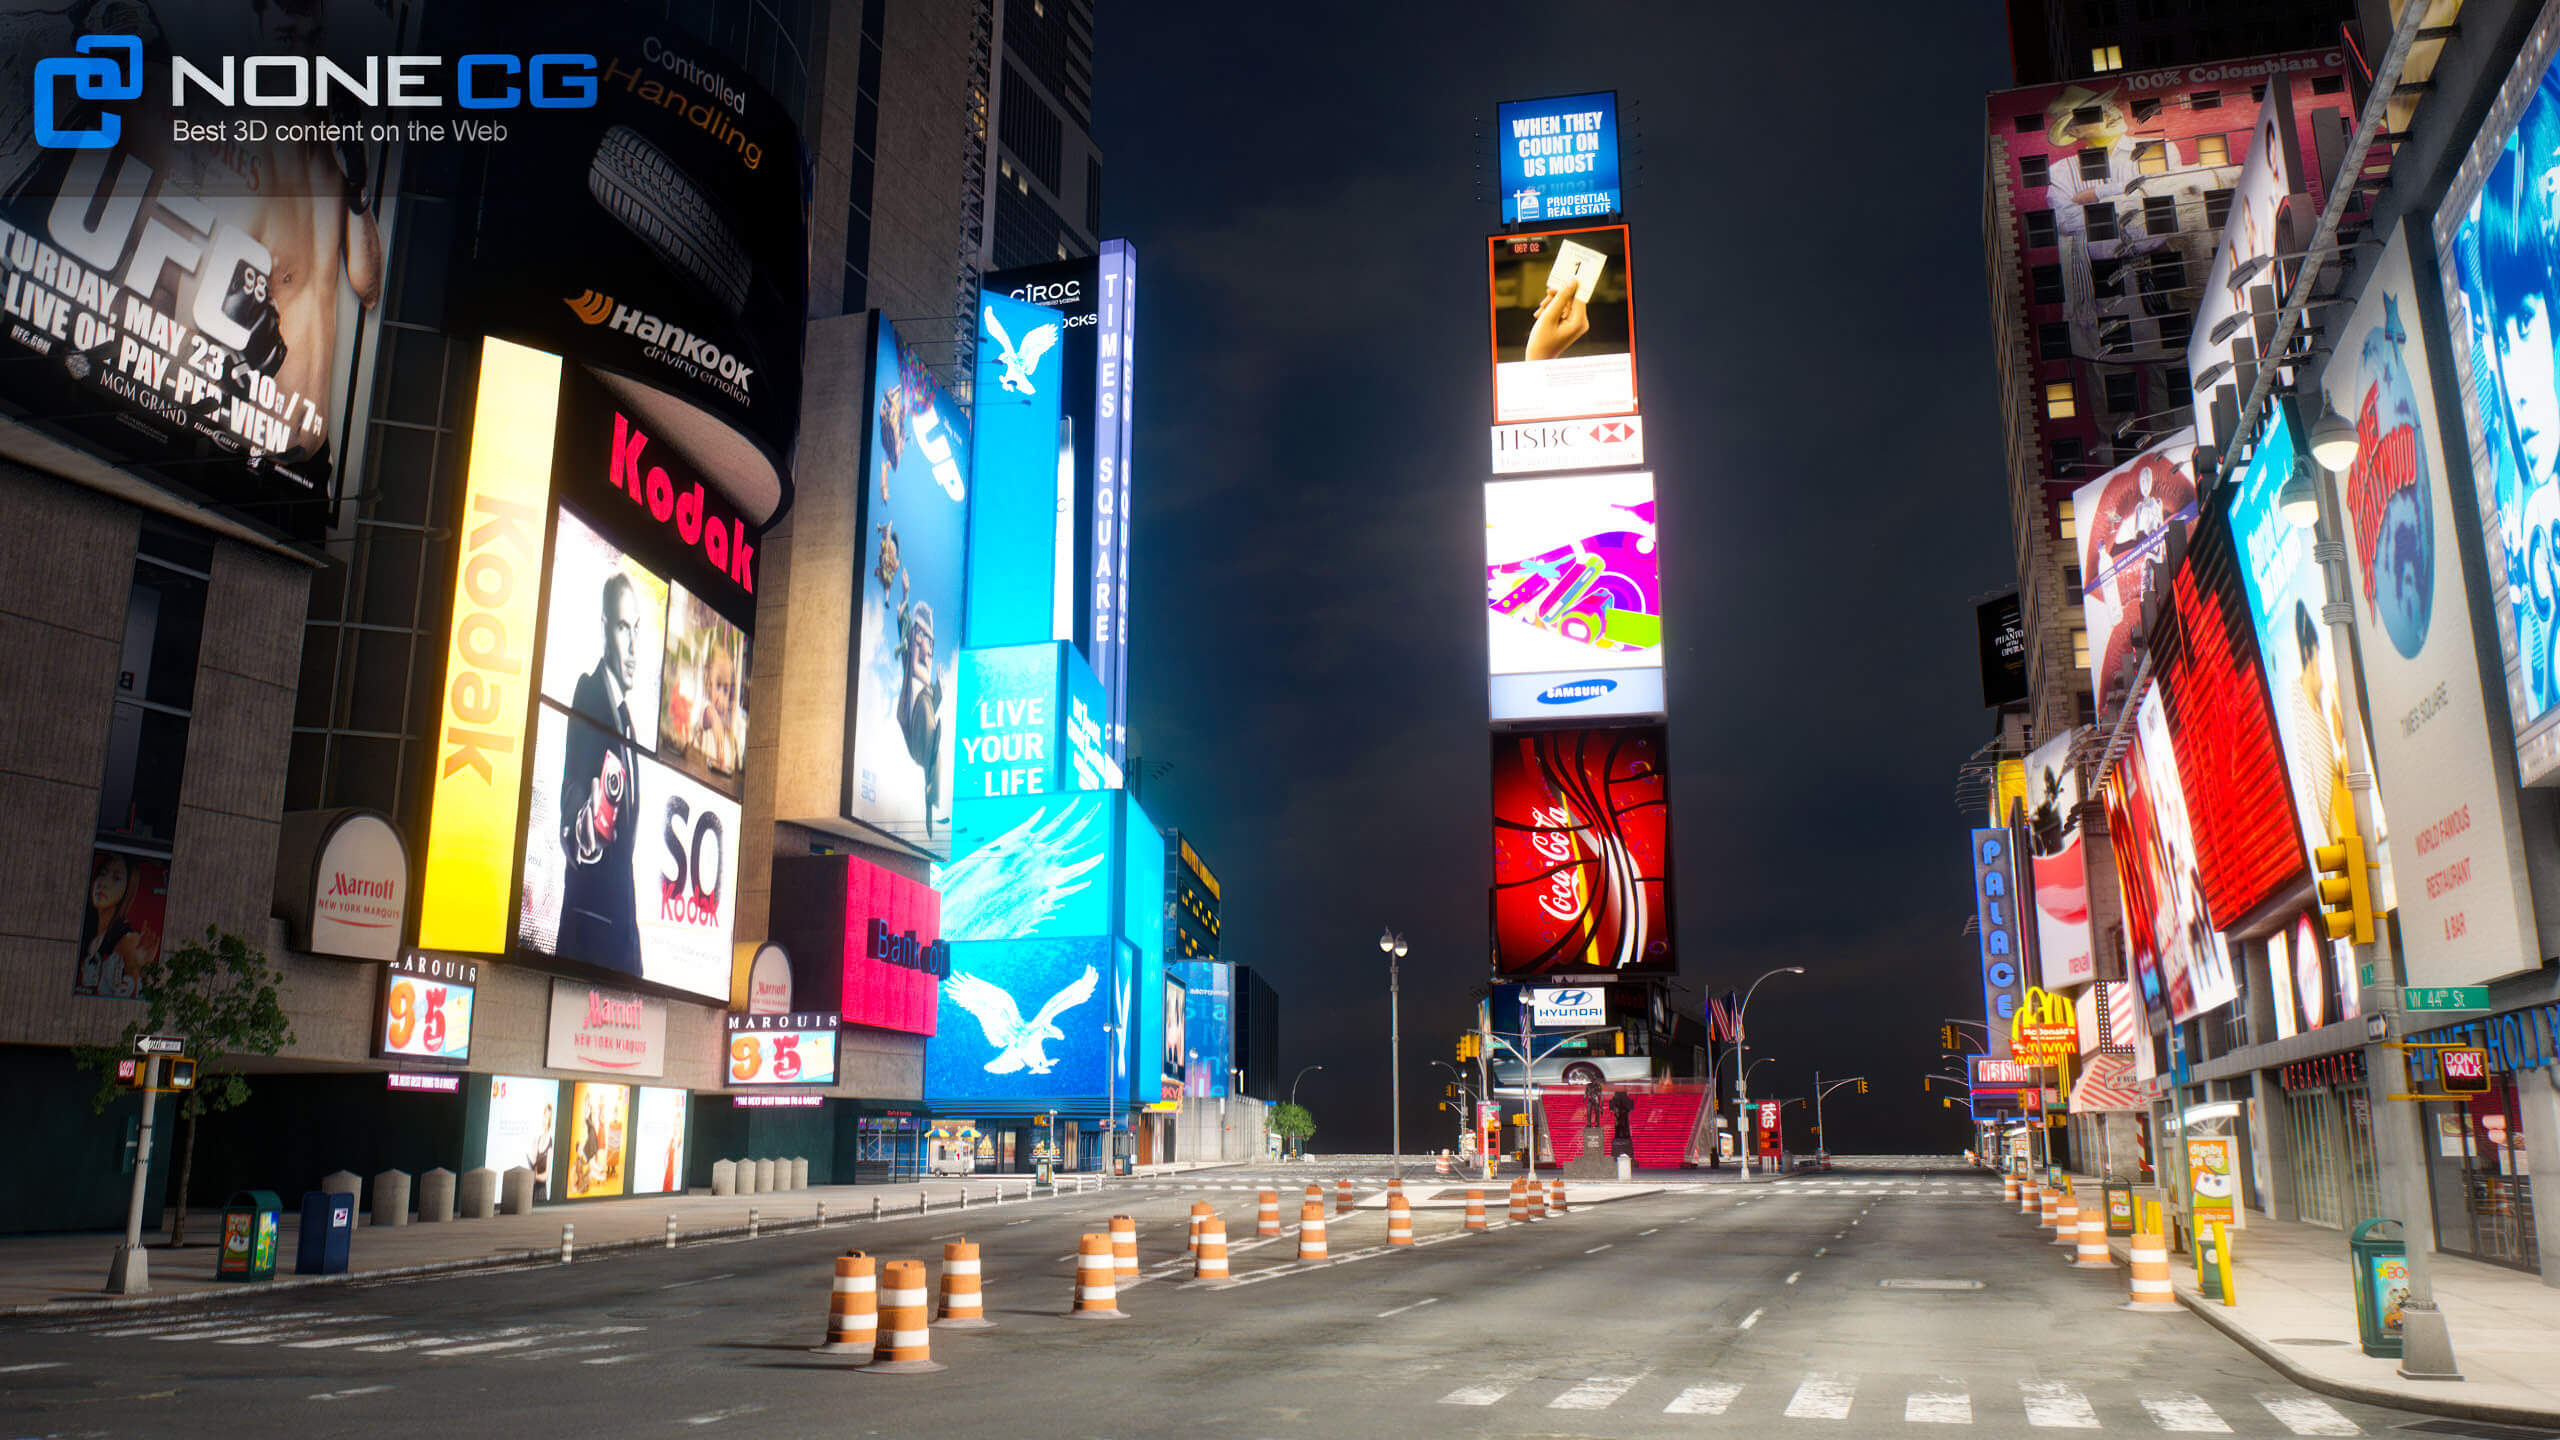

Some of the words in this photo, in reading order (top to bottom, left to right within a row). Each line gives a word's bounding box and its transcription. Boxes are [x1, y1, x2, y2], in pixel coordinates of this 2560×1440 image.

[642, 36, 746, 117] Controlled
[2127, 70, 2182, 92] 100%
[2188, 53, 2318, 83] Colombian
[602, 57, 763, 170] Handling
[1512, 115, 1561, 138] WHEN
[1563, 111, 1604, 133] THEY
[1518, 134, 1574, 158] COUNT
[1576, 132, 1600, 151] ON
[1523, 157, 1546, 178] US
[1549, 152, 1597, 175] MOST
[1546, 191, 1611, 207] PRUDENTIAL
[1547, 206, 1573, 218] REAL
[1575, 202, 1612, 214] ESTATE
[47, 142, 273, 352] UFC
[4, 271, 73, 341] LIVE
[1062, 313, 1097, 329] OCKS
[122, 294, 188, 358] MAY
[187, 334, 226, 382] 23
[1100, 273, 1118, 419] TIMES
[99, 368, 138, 402] MGM
[642, 343, 699, 380] driving
[699, 369, 752, 408] emotion
[609, 410, 755, 595] Kodak
[1095, 456, 1114, 643] SQUARE
[442, 493, 541, 788] Kodak
[1546, 685, 1609, 699] SAMSUNG
[979, 698, 1045, 729] LIVE
[961, 732, 1045, 765] YOUR
[984, 767, 1044, 798] LIFE
[2415, 822, 2440, 857] WORLD
[2440, 802, 2471, 846] FAMOUS
[328, 872, 395, 901] Marriott
[2425, 856, 2472, 900] RESTAURANT
[318, 898, 337, 911] NEW
[339, 901, 362, 914] YORK
[363, 904, 400, 921] MARQUIS
[875, 917, 922, 970] Bank
[1981, 839, 2015, 1019] PALACE
[582, 990, 643, 1030] Marriott
[1539, 1008, 1603, 1017] HYUNDAI
[2444, 1052, 2481, 1065] DONT
[2446, 1063, 2484, 1077] WALK
[1761, 1102, 1777, 1129] tkts
